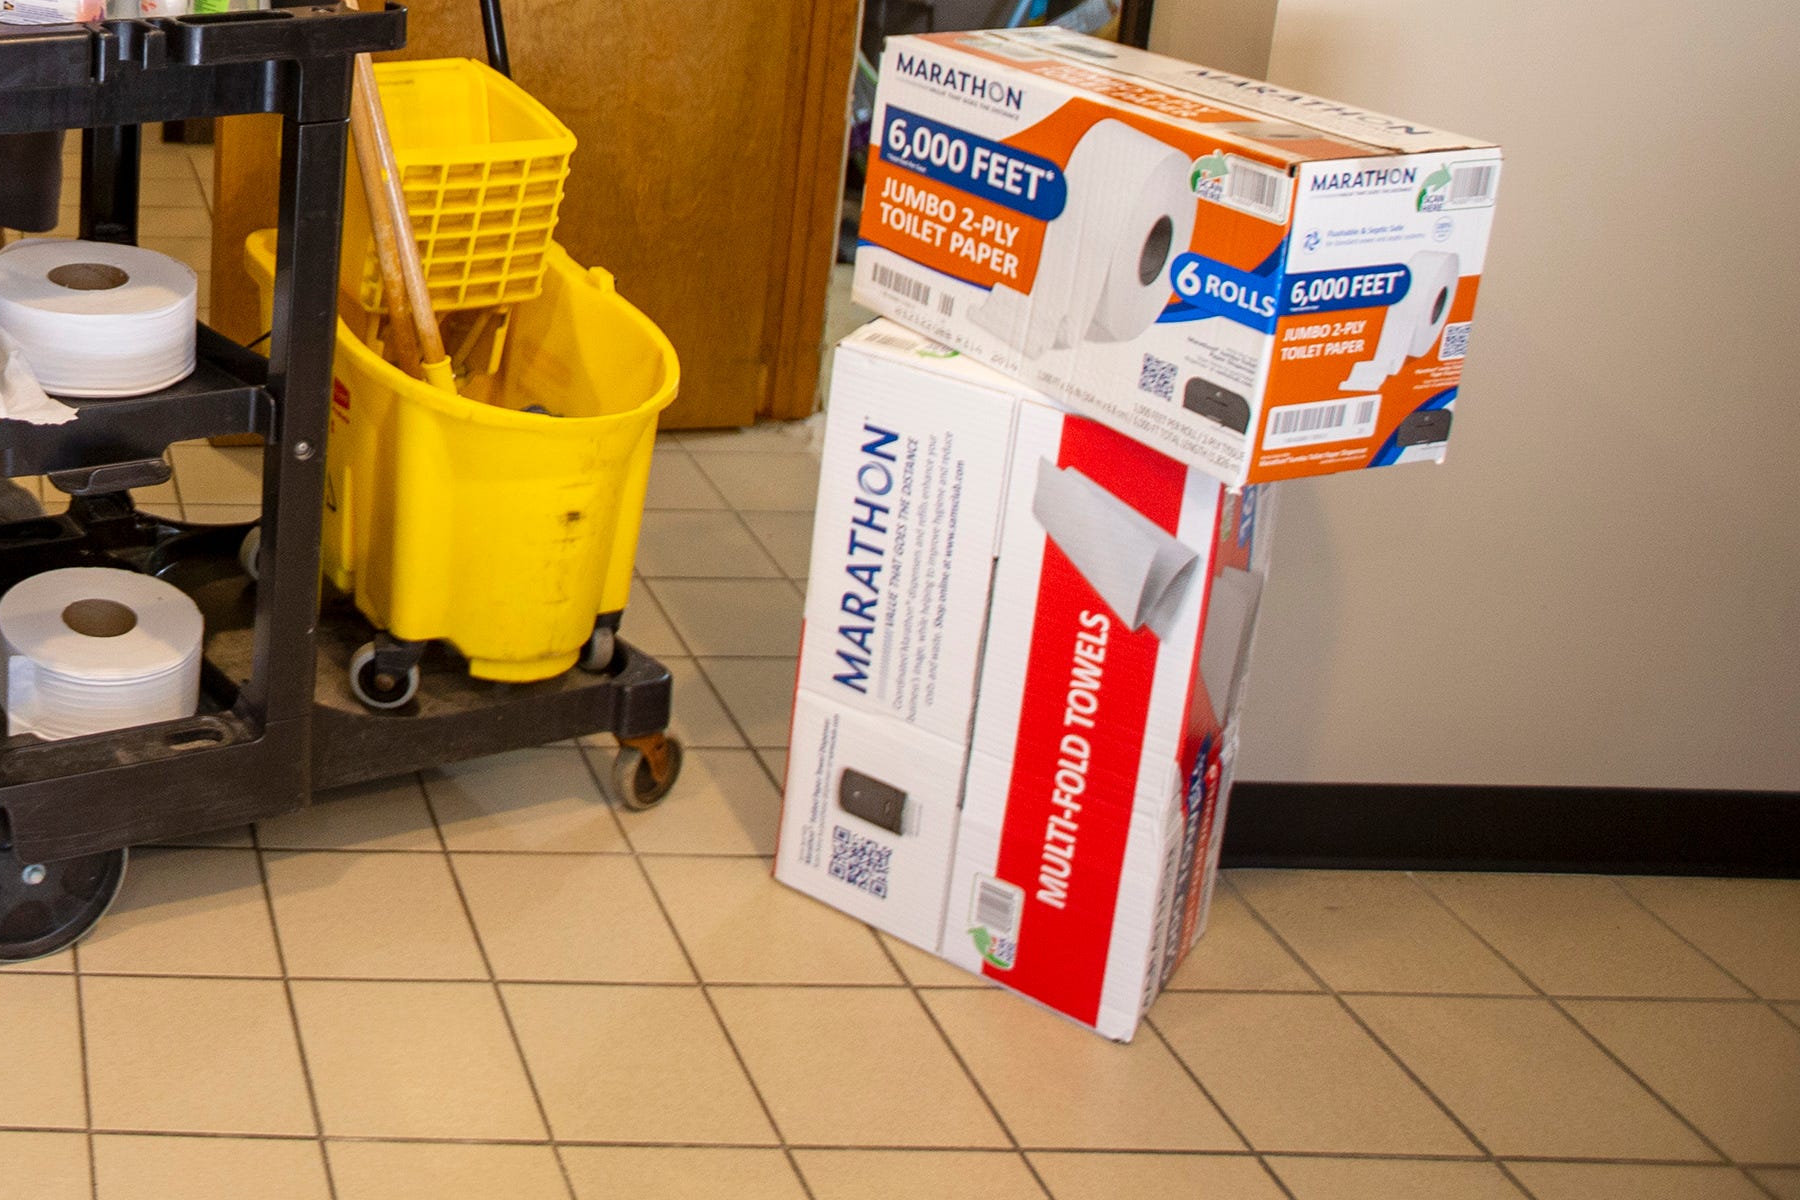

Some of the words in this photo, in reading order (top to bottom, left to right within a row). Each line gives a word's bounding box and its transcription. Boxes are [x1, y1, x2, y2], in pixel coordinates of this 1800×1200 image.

[896, 52, 1023, 111] MARATHON
[888, 119, 968, 174] 6,000
[1310, 166, 1417, 192] MARATHON
[880, 202, 947, 248] TOILET
[949, 231, 1019, 280] PAPER
[881, 177, 956, 223] JUMBO
[959, 207, 1020, 248] 2-PLY
[1176, 261, 1201, 296] 6
[1205, 274, 1276, 318] ROLLS
[1290, 276, 1350, 307] 6,000
[1280, 343, 1323, 361] TOILET
[1325, 339, 1365, 355] PAPER
[1282, 323, 1331, 342] JUMBO
[1332, 320, 1367, 336] 2-PLY
[901, 436, 919, 497] DISTANCE
[898, 497, 911, 520] THE
[832, 423, 900, 695] MARATHON
[894, 523, 908, 556] GOES
[1063, 608, 1111, 729] TOWELS
[1035, 733, 1092, 911] MULTI-FOLD
